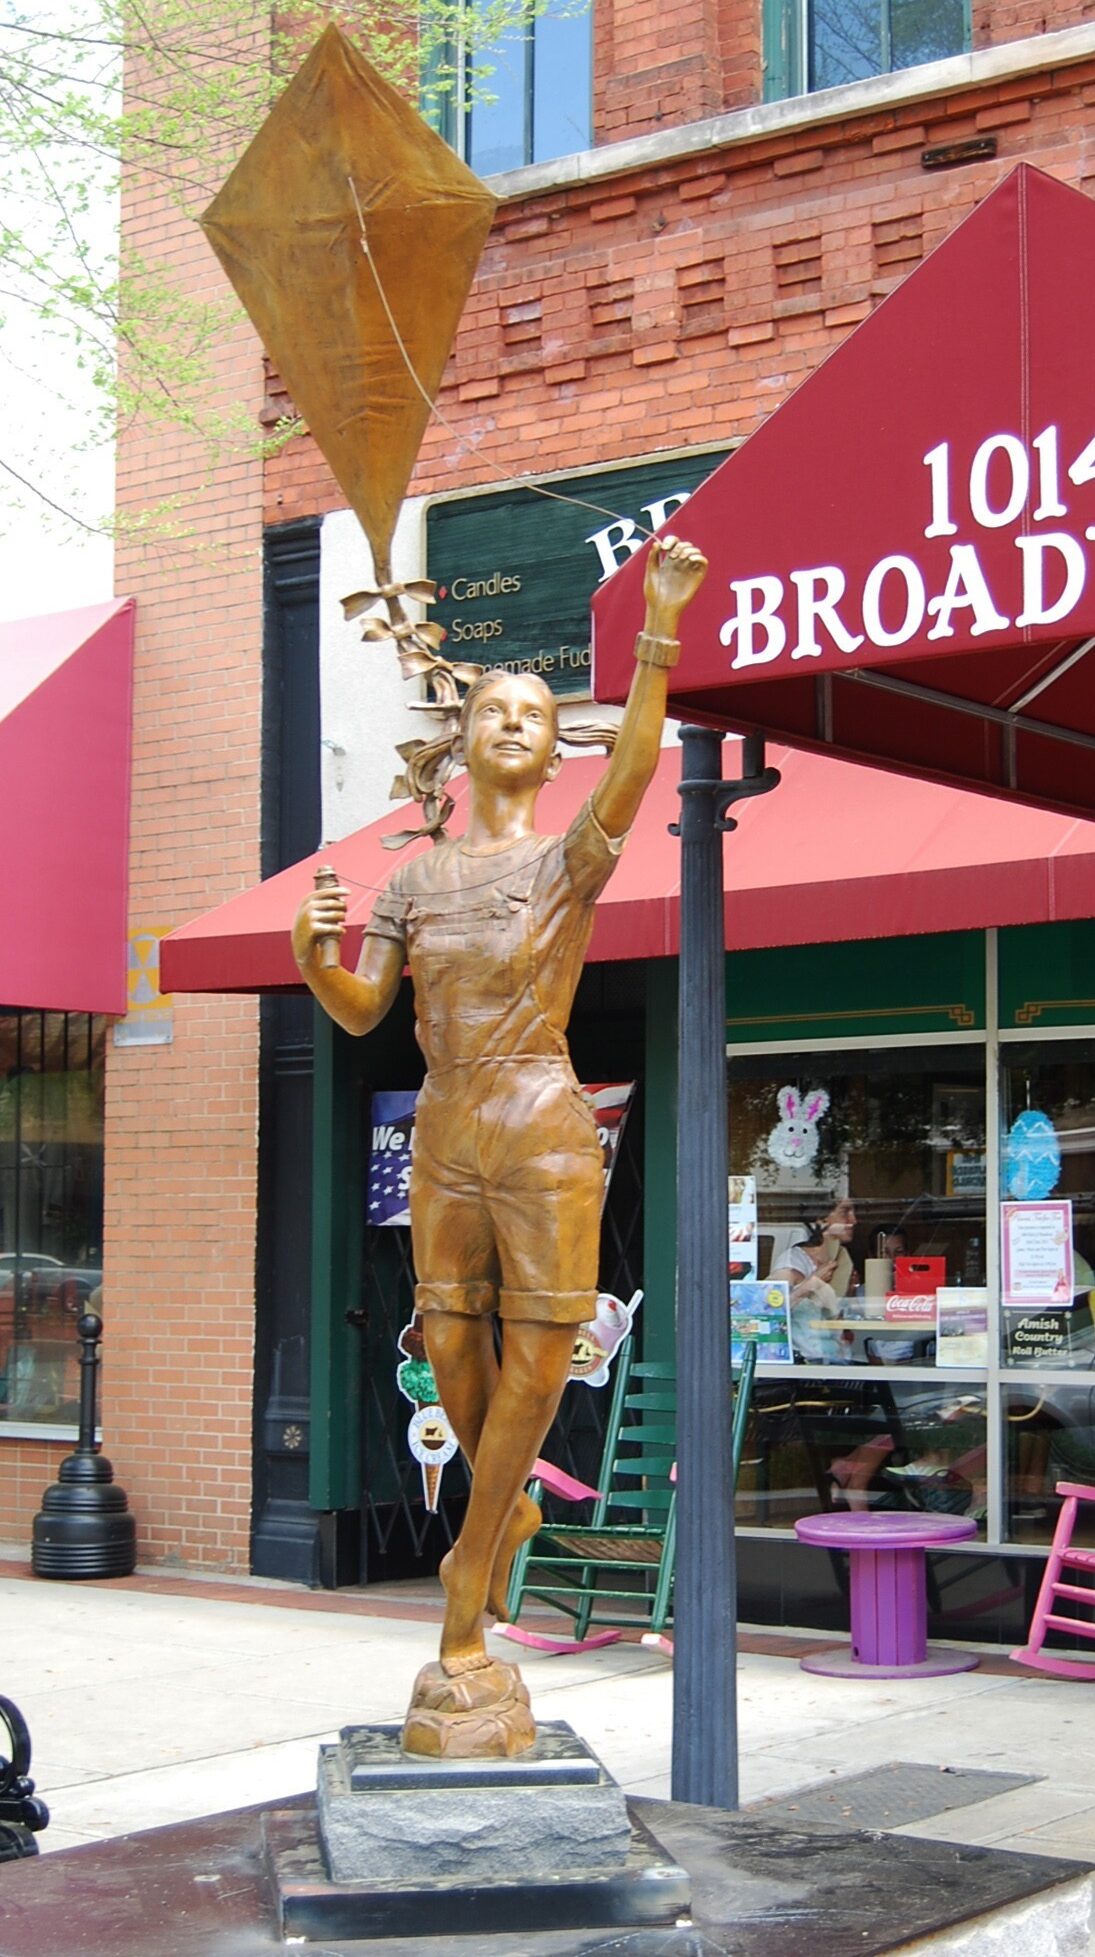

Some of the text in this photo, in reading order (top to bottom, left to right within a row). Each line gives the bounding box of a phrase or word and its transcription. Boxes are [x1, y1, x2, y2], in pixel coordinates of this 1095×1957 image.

[451, 571, 521, 601] Candles
[719, 526, 1095, 670] BROAD
[452, 618, 503, 644] Soaps
[372, 1125, 406, 1151] We
[1017, 1317, 1060, 1330] Amish
[1014, 1330, 1063, 1345] Country
[1012, 1346, 1068, 1358] Roll Butter
